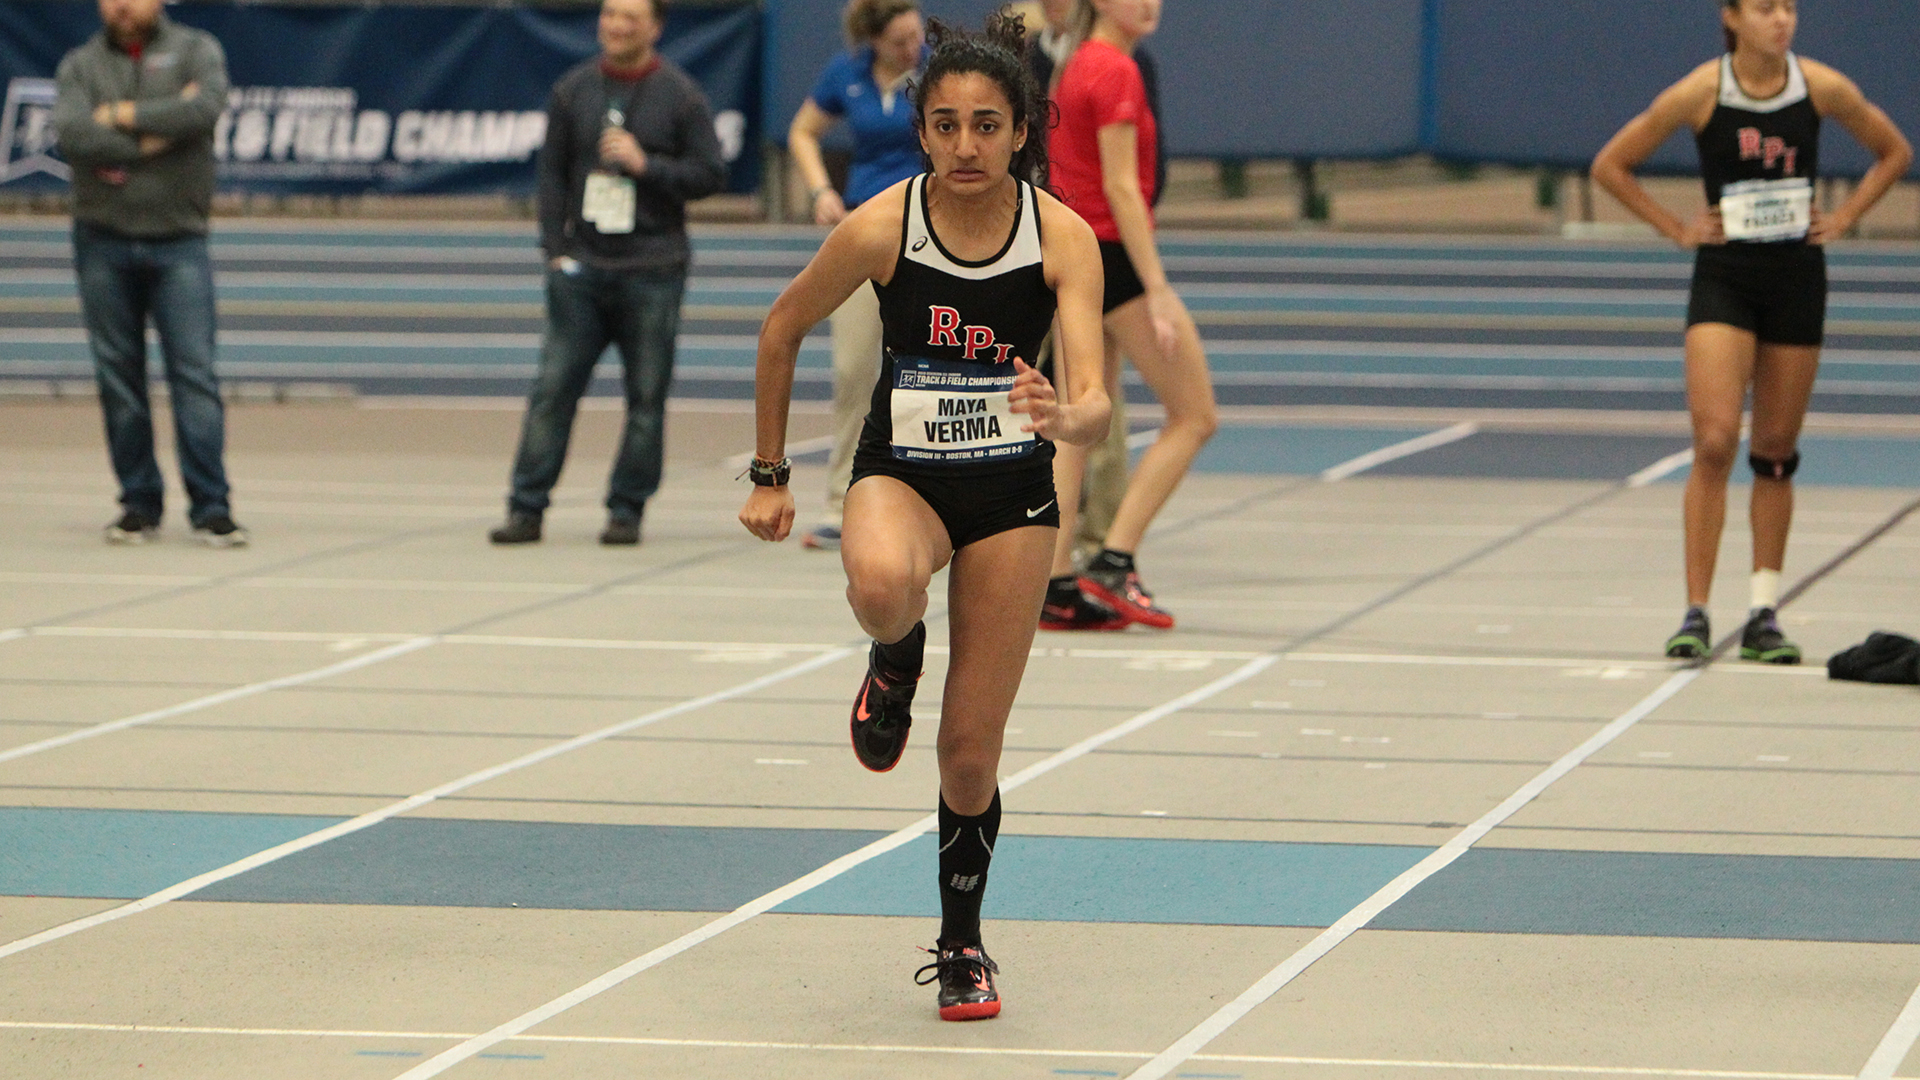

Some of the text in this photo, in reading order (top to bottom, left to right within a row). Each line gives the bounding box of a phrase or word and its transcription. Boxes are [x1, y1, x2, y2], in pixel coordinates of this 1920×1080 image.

[270, 109, 391, 161] FIELD
[392, 109, 549, 163] CHAMP
[928, 305, 1014, 364] RPI
[917, 375, 1019, 386] TRACK & FIELD CHAMPIONSH
[938, 398, 987, 416] MAYA
[924, 415, 1002, 443] VERMA
[906, 450, 933, 459] DIVISION
[974, 450, 984, 458] MA
[989, 447, 1011, 456] MARCH
